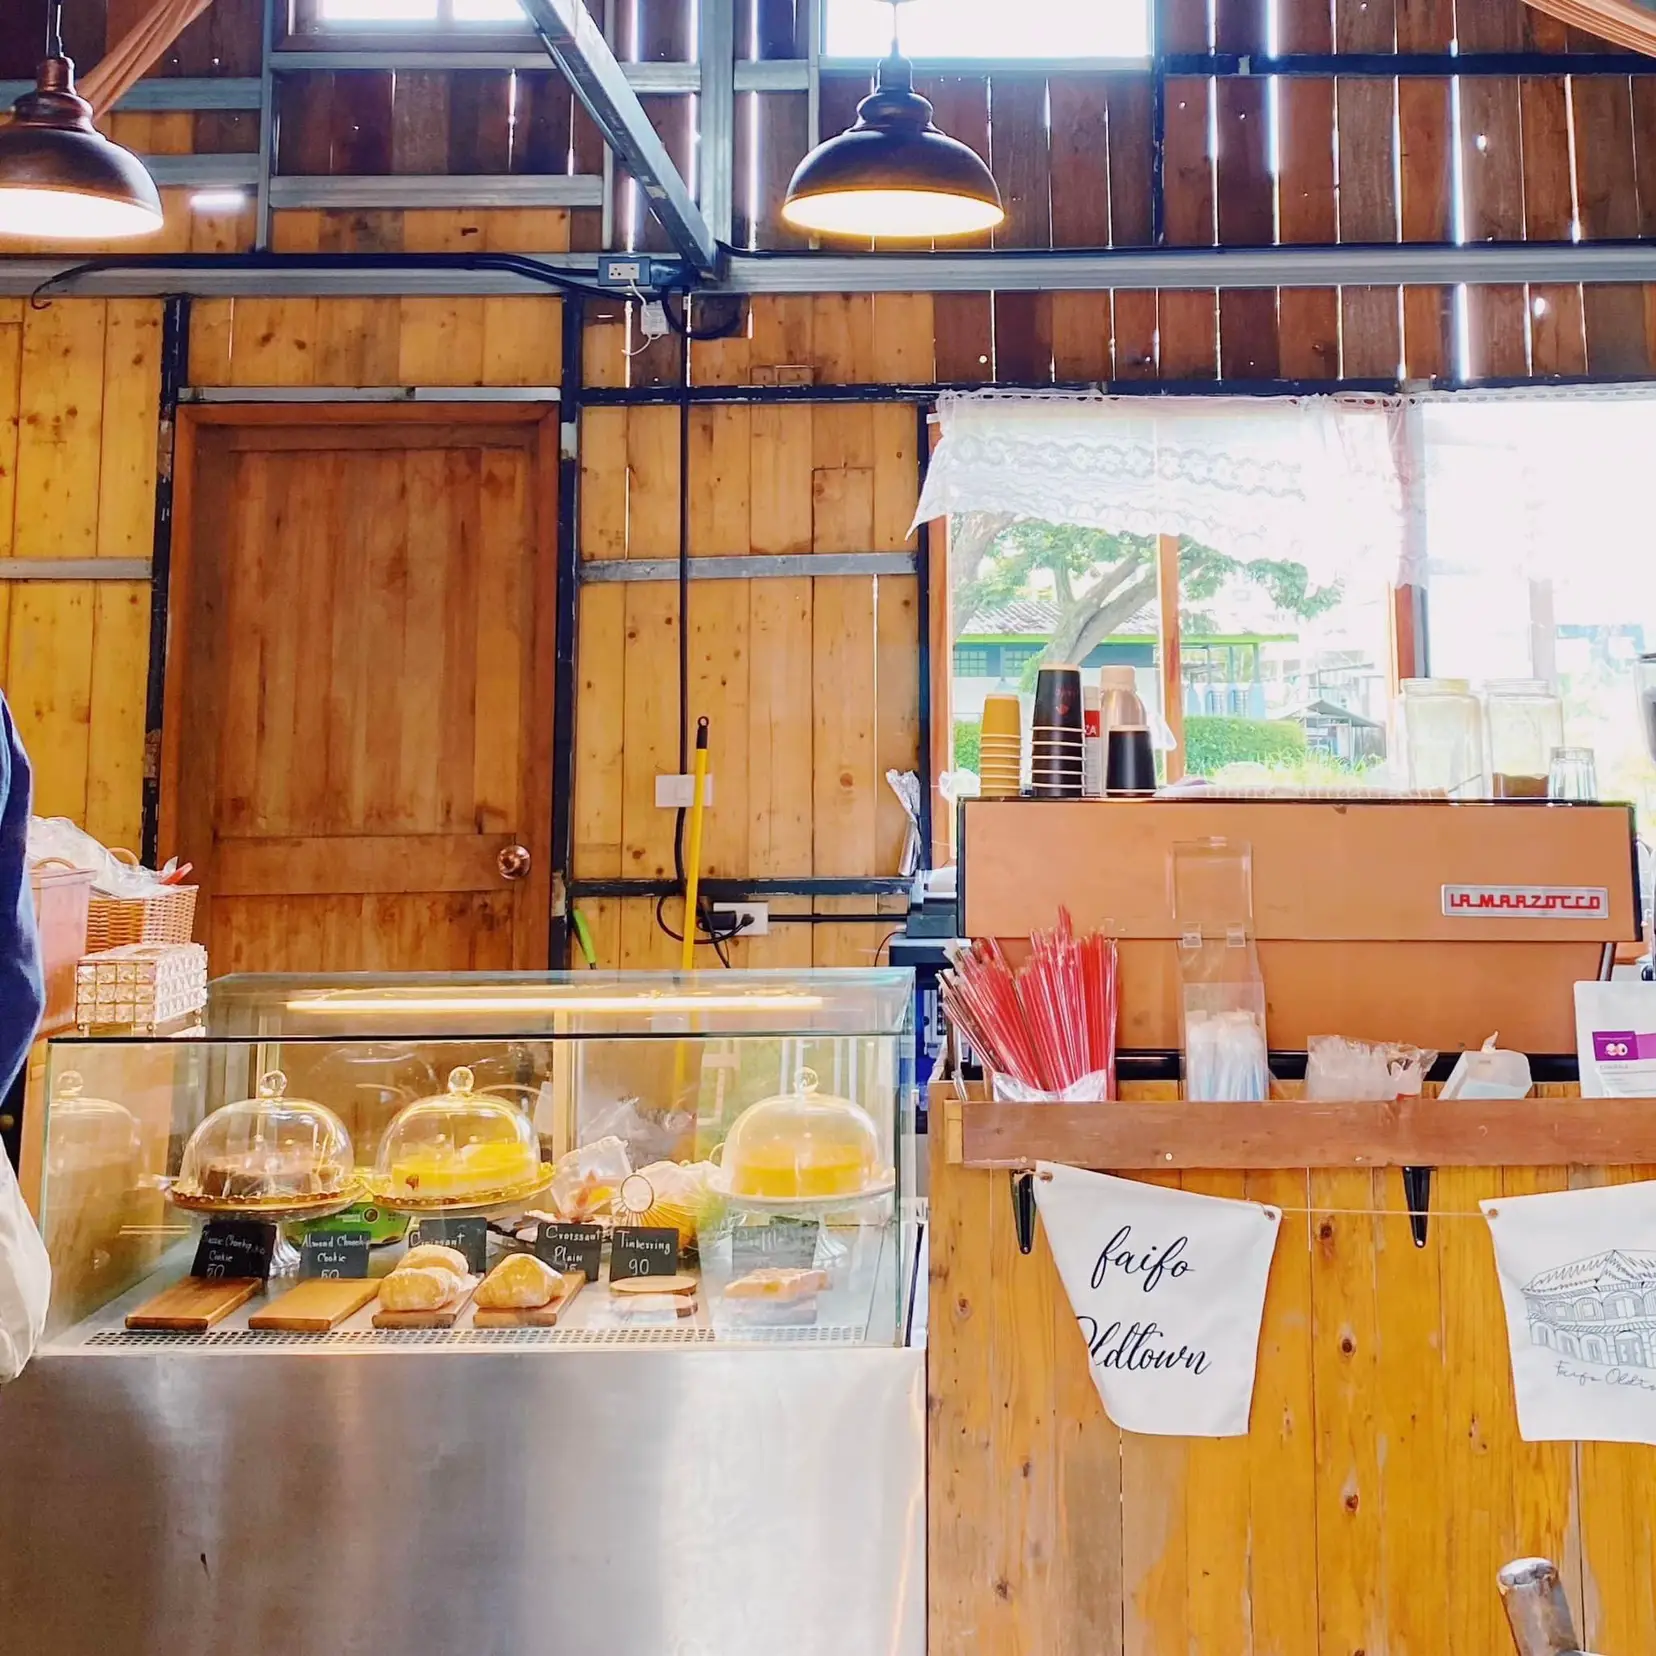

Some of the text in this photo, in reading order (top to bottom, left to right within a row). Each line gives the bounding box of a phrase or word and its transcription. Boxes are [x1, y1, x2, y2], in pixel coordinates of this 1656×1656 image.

[1450, 893, 1472, 908] LA
[301, 1233, 334, 1249] Almond
[545, 1225, 602, 1242] Croissant
[317, 1251, 347, 1263] Cookie
[554, 1245, 583, 1263] Plain
[1090, 1225, 1196, 1293] faifo
[628, 1258, 650, 1276] 90
